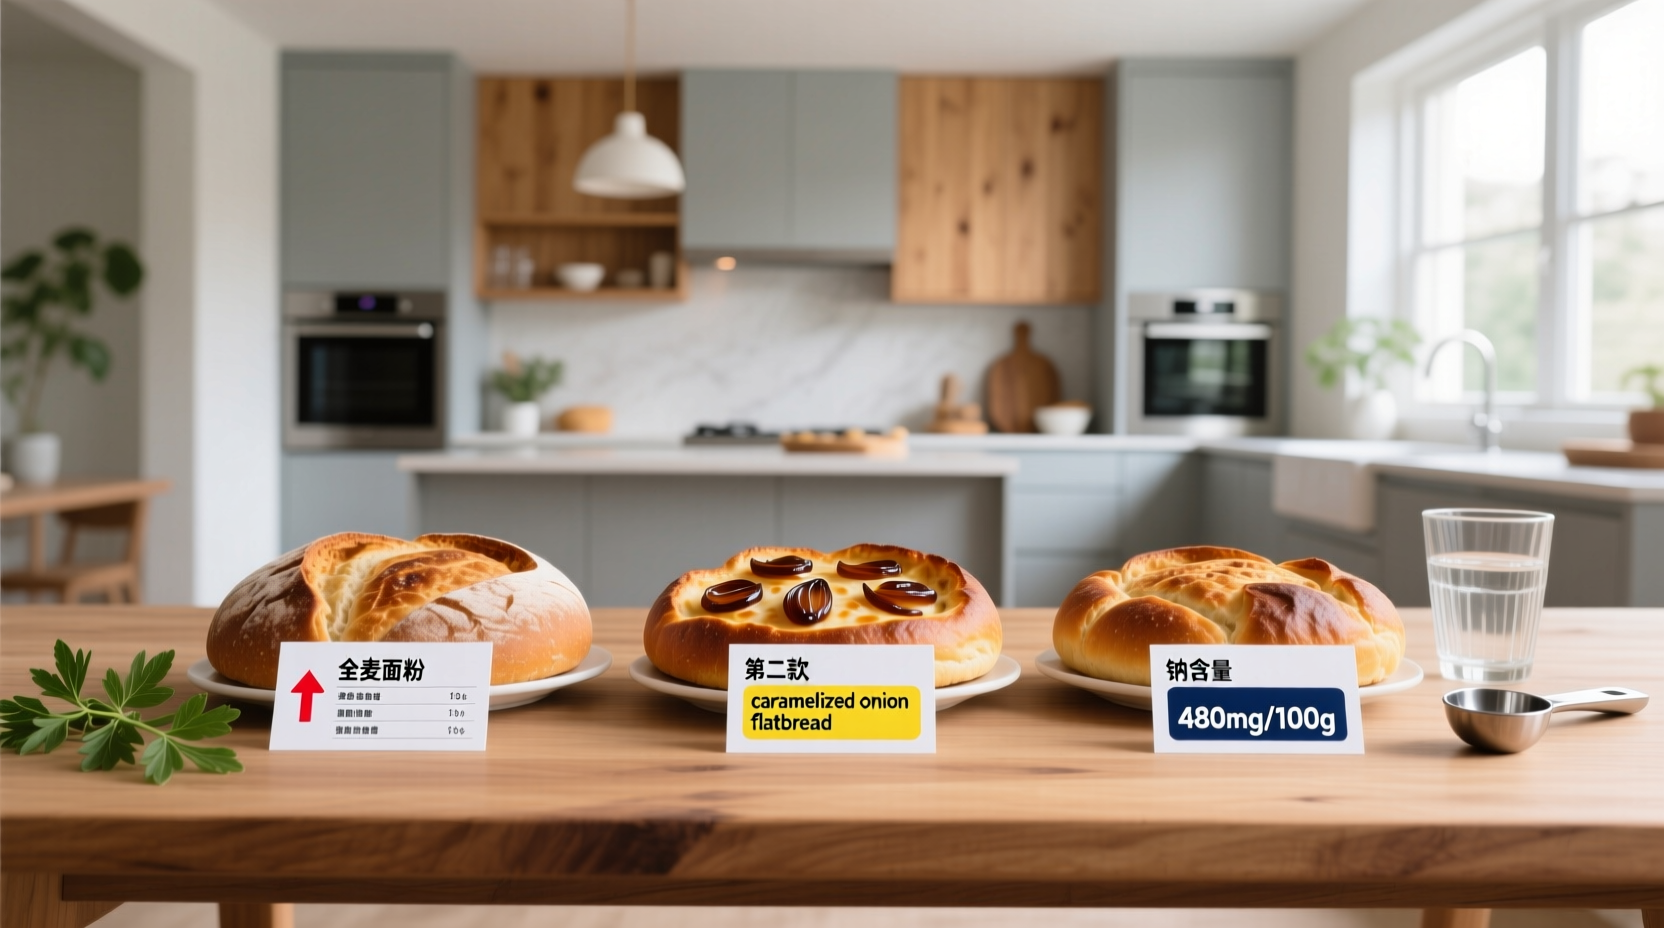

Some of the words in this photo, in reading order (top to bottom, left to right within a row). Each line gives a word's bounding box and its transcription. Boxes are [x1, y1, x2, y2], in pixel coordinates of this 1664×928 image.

[338, 656, 425, 682] 全麦面粉
[745, 657, 810, 681] 第二款
[1166, 658, 1232, 682] 钠含量
[751, 692, 855, 709] caramelized
[860, 692, 909, 710] onion
[751, 713, 832, 731] flatbread
[1178, 705, 1336, 737] 480mg/100g
